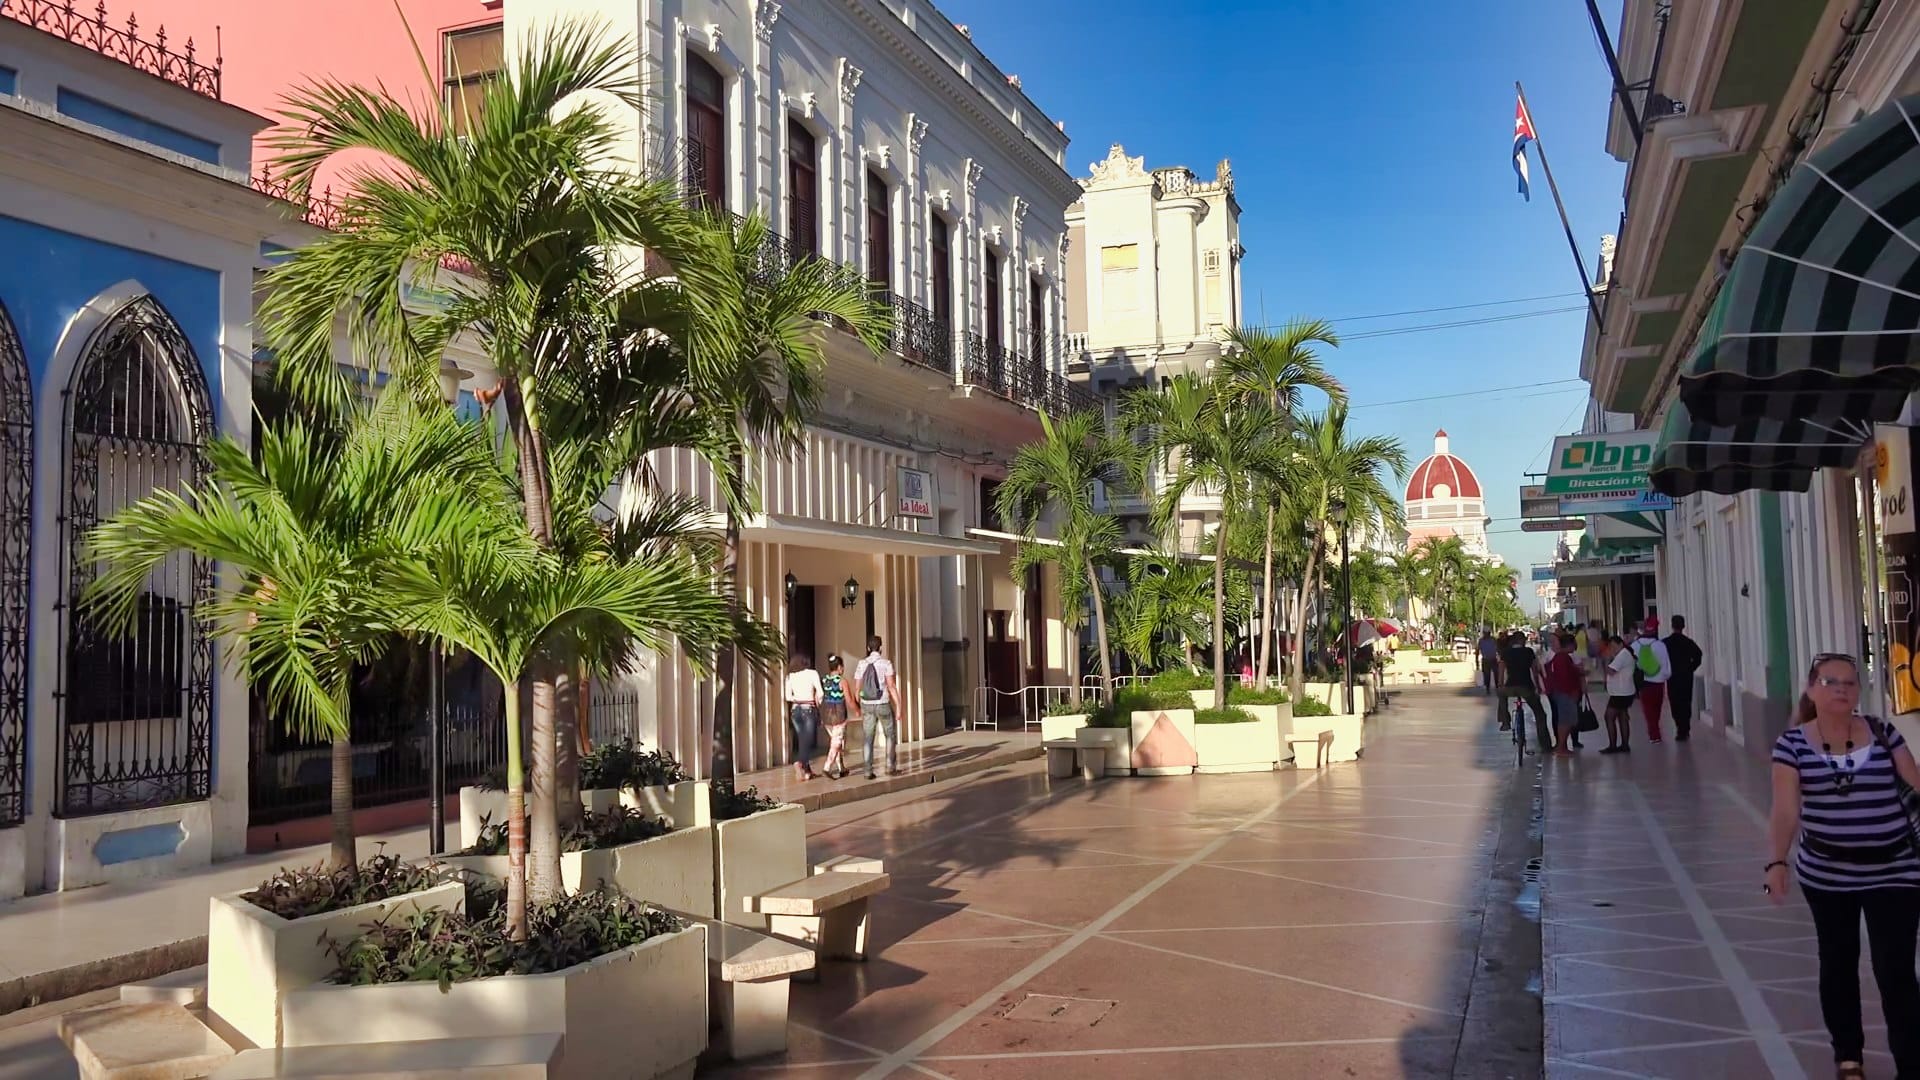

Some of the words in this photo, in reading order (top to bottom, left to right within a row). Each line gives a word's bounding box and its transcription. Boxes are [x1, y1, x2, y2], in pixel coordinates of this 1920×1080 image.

[1568, 477, 1630, 488] Dirección
[900, 498, 910, 511] La
[911, 500, 930, 514] Ideal
